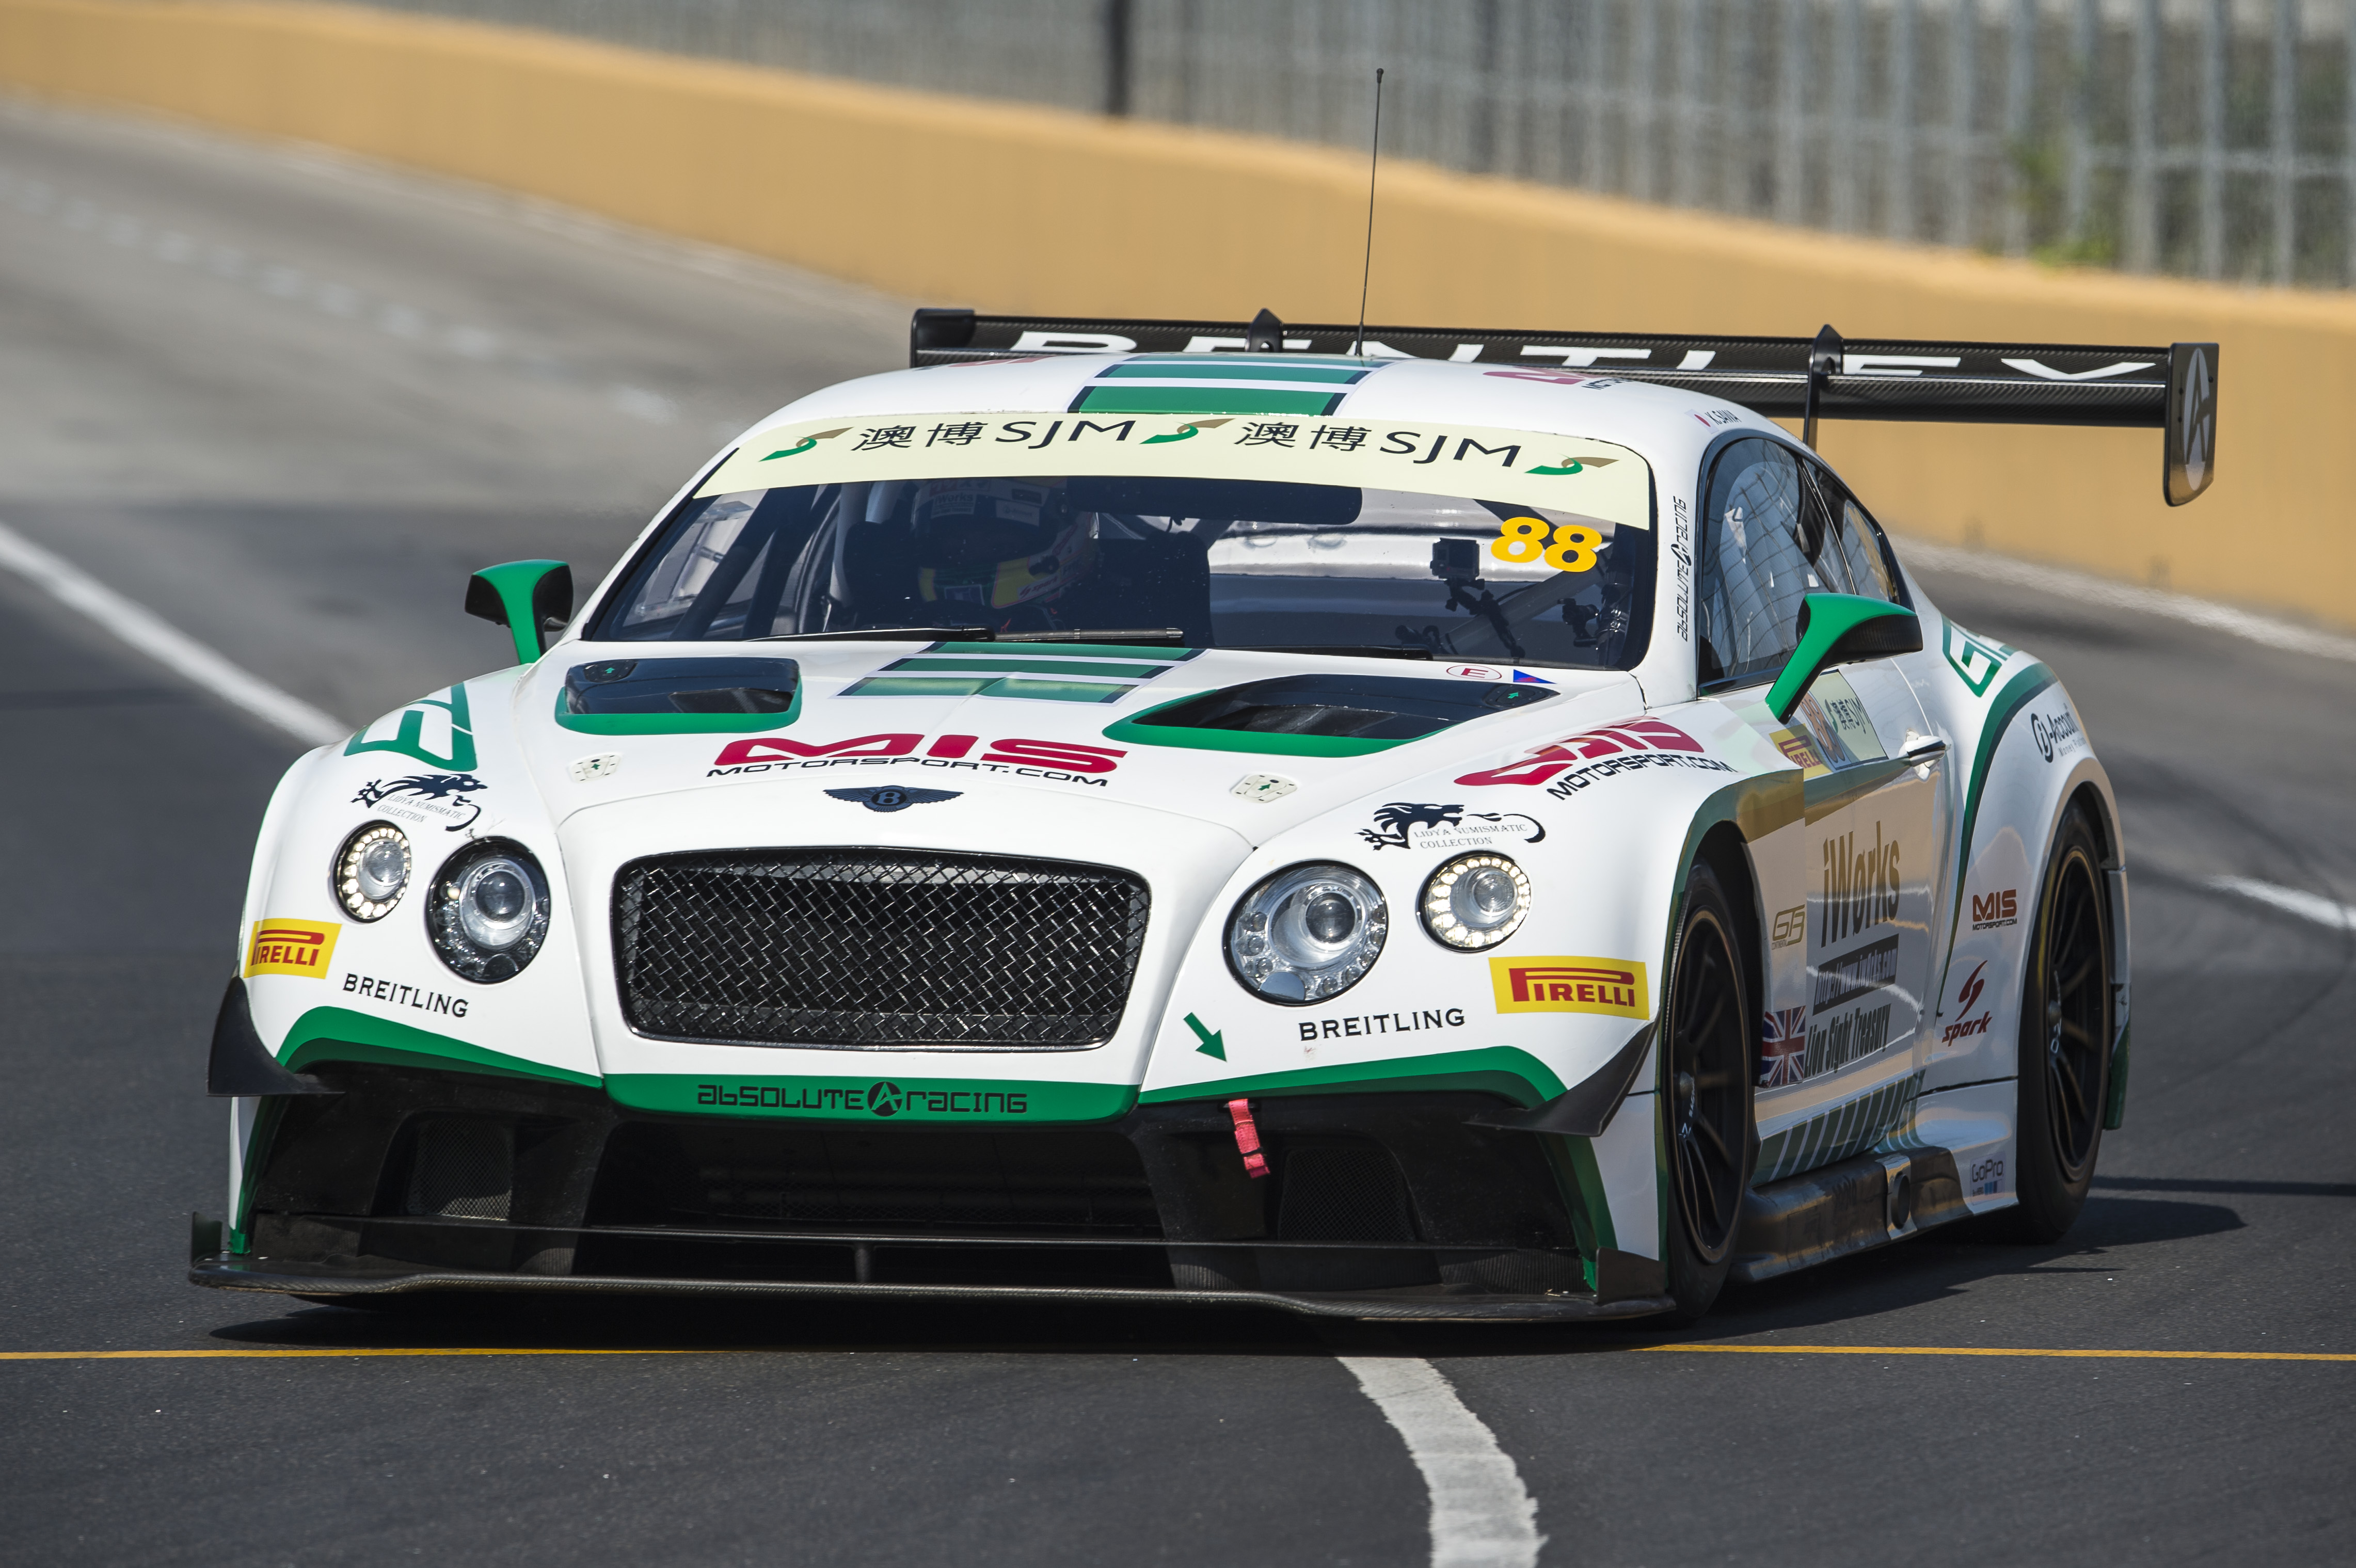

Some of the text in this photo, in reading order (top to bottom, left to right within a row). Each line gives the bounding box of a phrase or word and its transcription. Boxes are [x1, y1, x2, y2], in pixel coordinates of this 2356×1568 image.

[1490, 517, 1602, 572] 88
[713, 733, 1128, 773] MIS
[706, 757, 1108, 788] MOTORSPORT.COM
[1547, 754, 1739, 801] MOTORSPORT.COM
[381, 804, 427, 823] COLLECTION
[1414, 827, 1451, 838] LIDYA
[1420, 837, 1493, 849] COLLECTION
[1972, 889, 2017, 922] MIS
[250, 929, 325, 967] PIRELLI
[342, 973, 469, 1019] BREITLING
[1508, 967, 1636, 1007] PIRELLI
[1298, 1007, 1466, 1042] BREITLING
[1941, 1011, 1993, 1047] spark
[1971, 1159, 2004, 1183] GoPro
